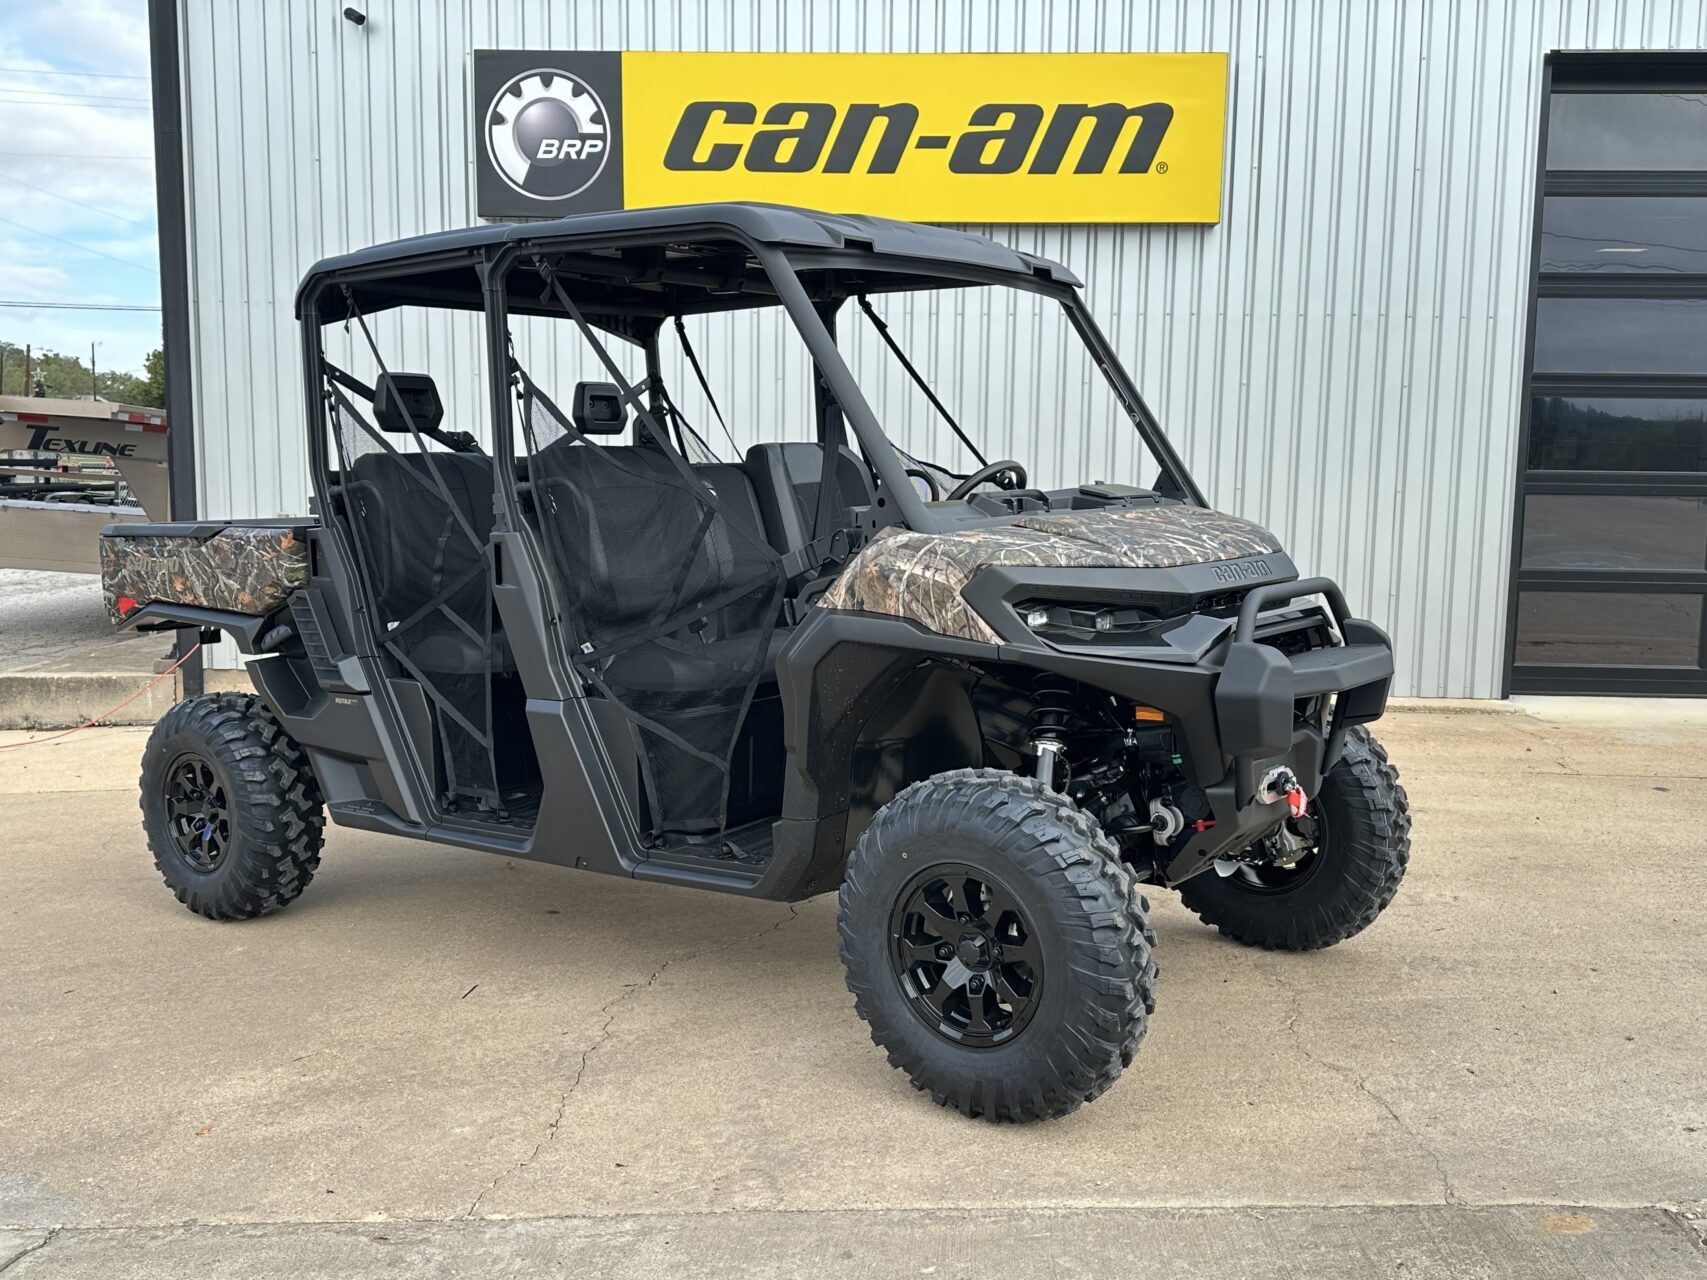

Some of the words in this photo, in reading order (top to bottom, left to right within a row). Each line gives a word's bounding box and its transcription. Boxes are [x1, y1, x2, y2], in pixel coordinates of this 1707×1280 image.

[536, 138, 604, 160] BRP
[25, 424, 137, 457] TEXLINE
[1210, 560, 1273, 582] can-am
